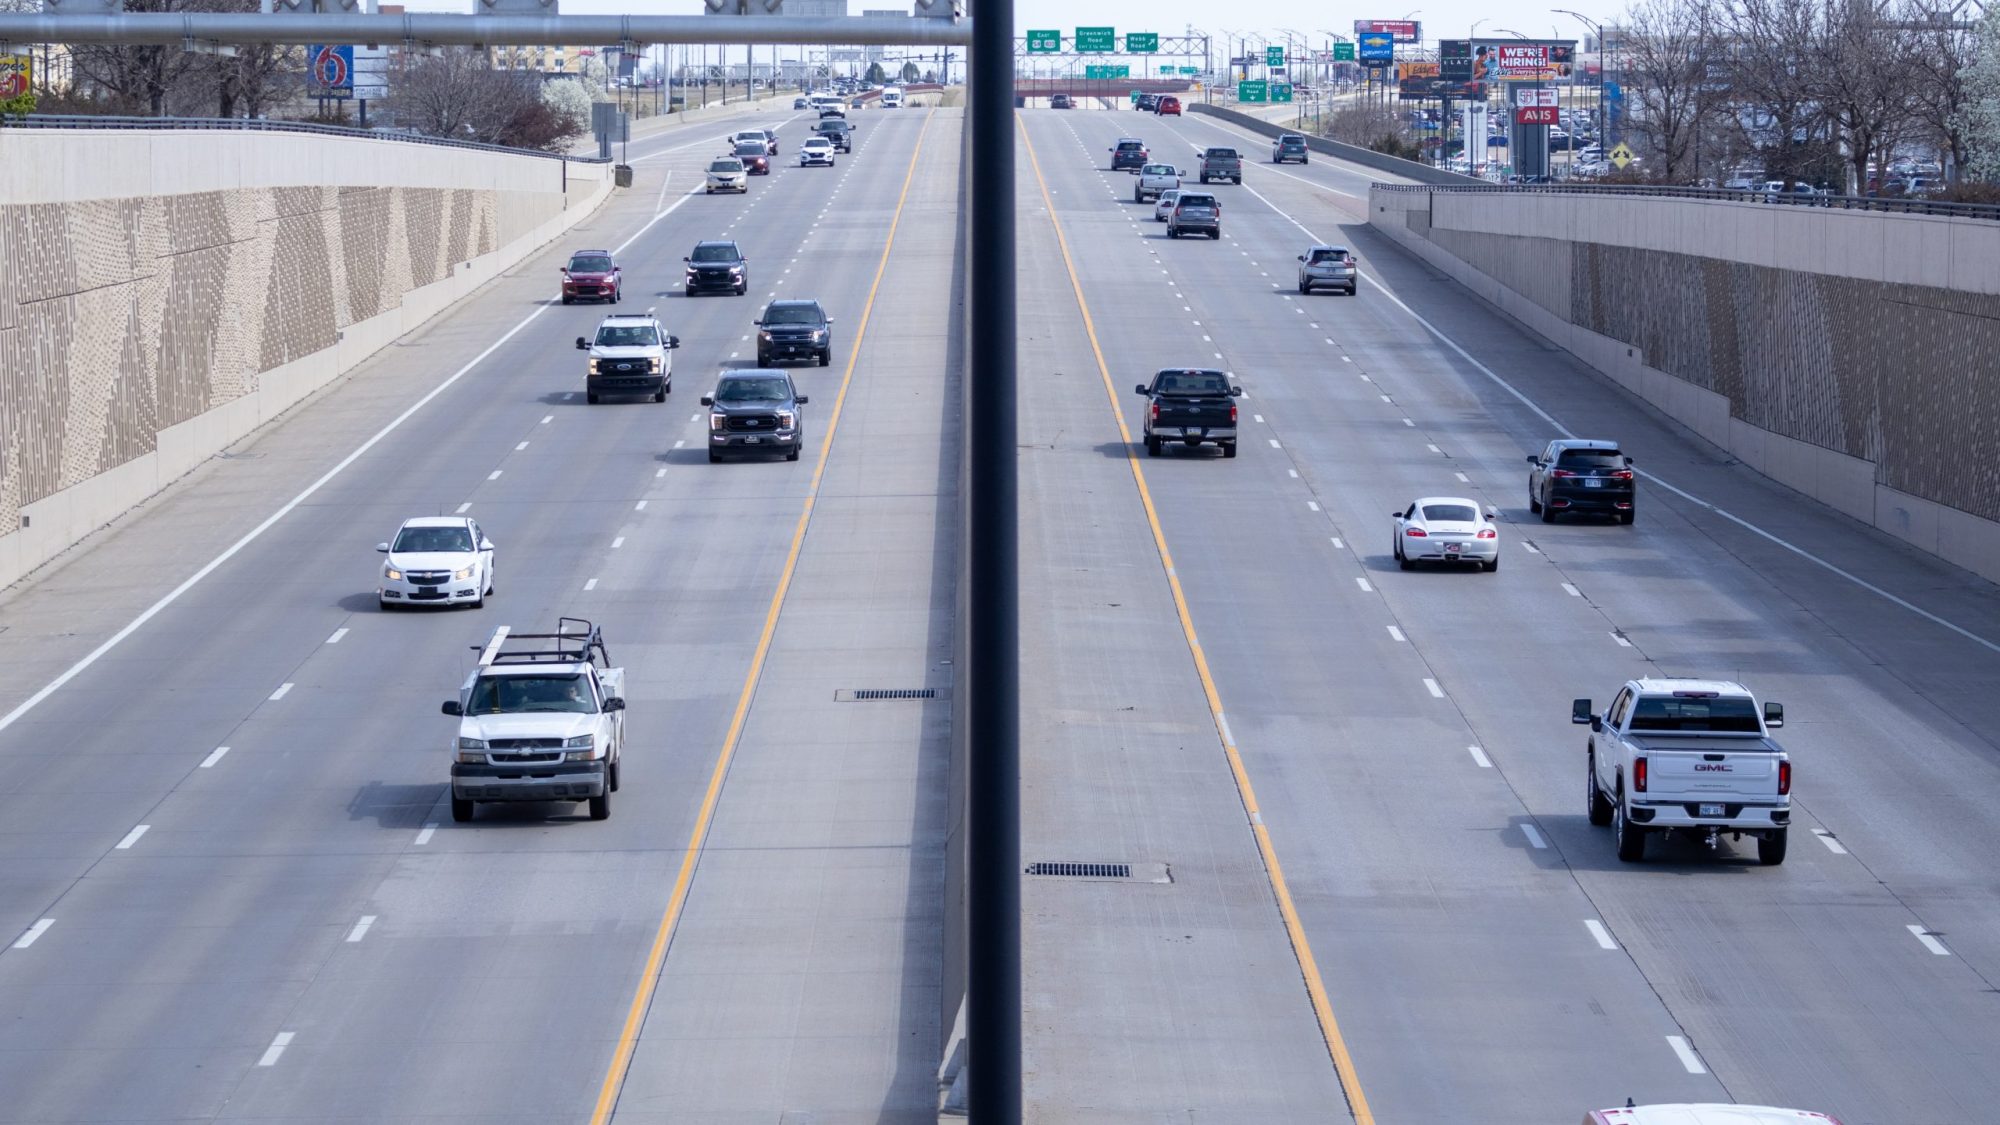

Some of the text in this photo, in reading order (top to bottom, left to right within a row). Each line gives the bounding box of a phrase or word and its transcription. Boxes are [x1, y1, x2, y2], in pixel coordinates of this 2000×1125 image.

[1504, 48, 1544, 57] WE'RE
[314, 45, 347, 87] 6
[1501, 57, 1546, 66] HIRING!
[1524, 110, 1551, 120] AVIS
